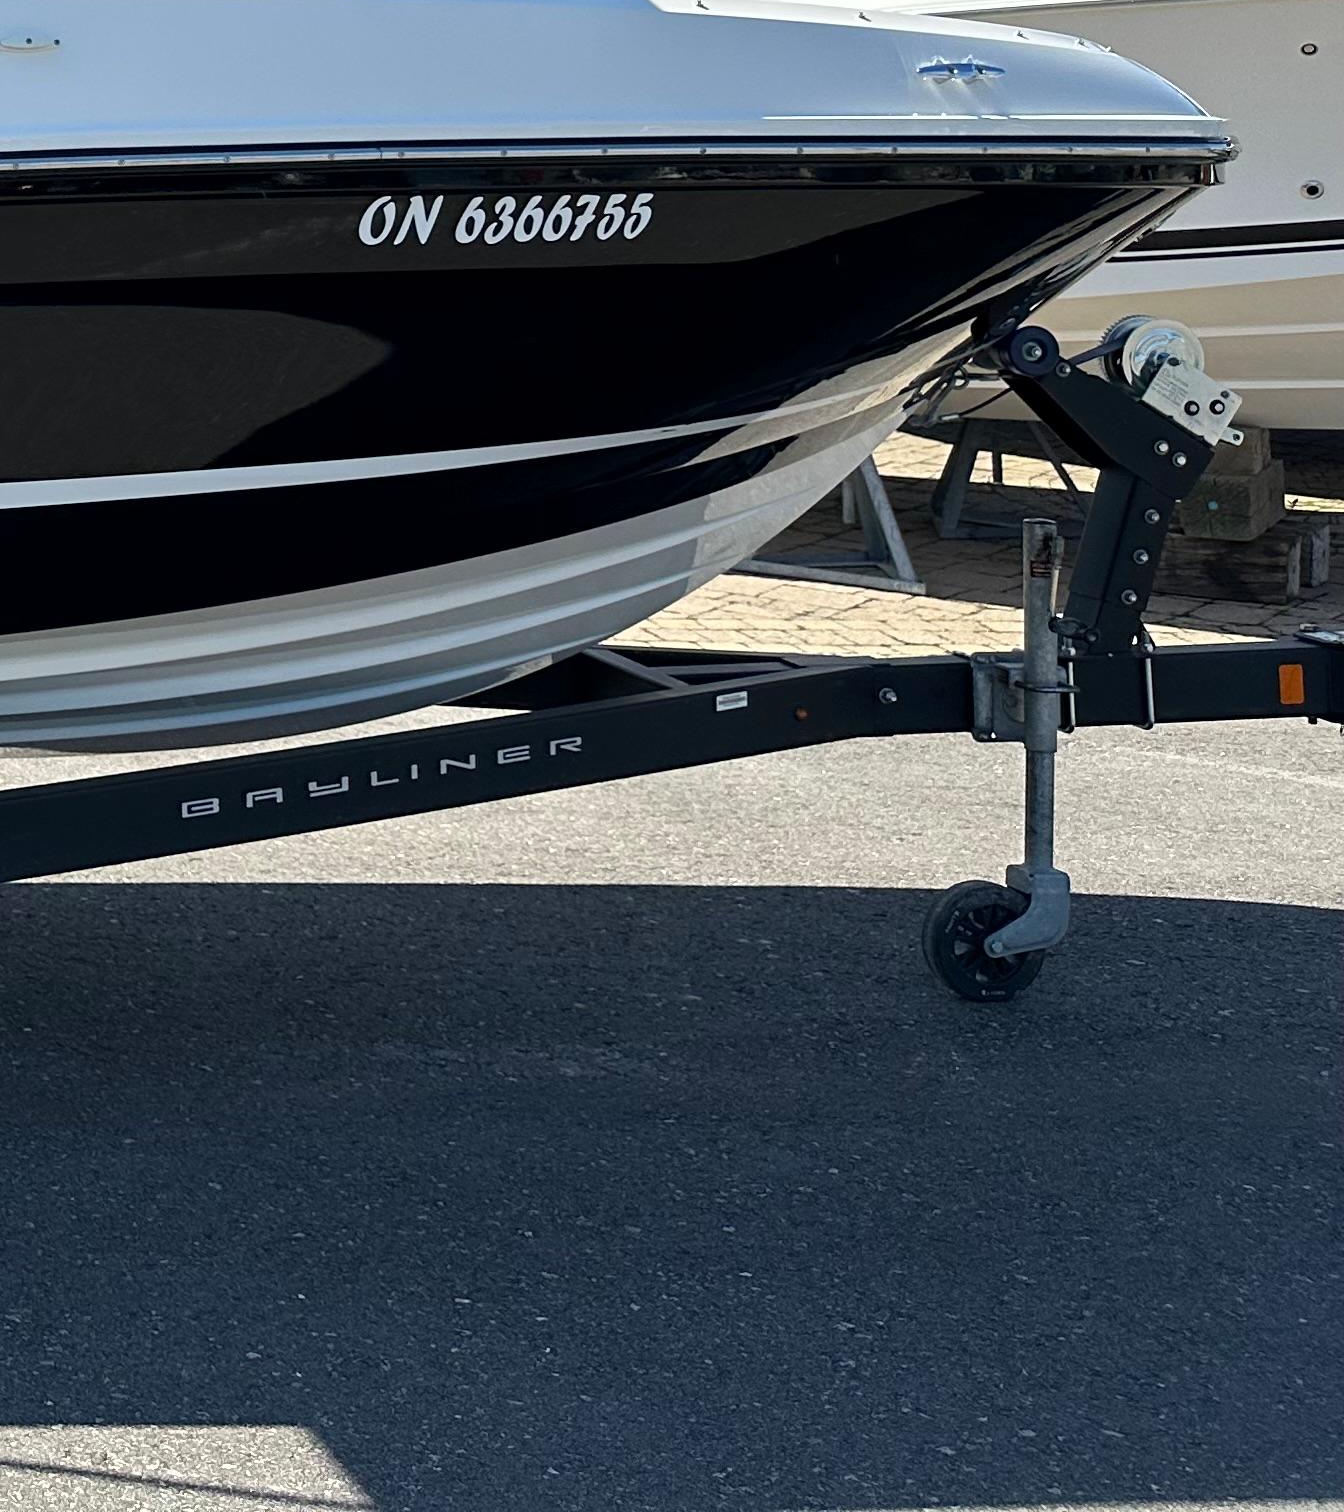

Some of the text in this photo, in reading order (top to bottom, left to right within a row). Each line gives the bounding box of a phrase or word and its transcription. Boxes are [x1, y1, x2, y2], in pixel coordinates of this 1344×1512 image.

[358, 192, 655, 246] ON 6366755
[181, 736, 583, 819] BAYLINER
